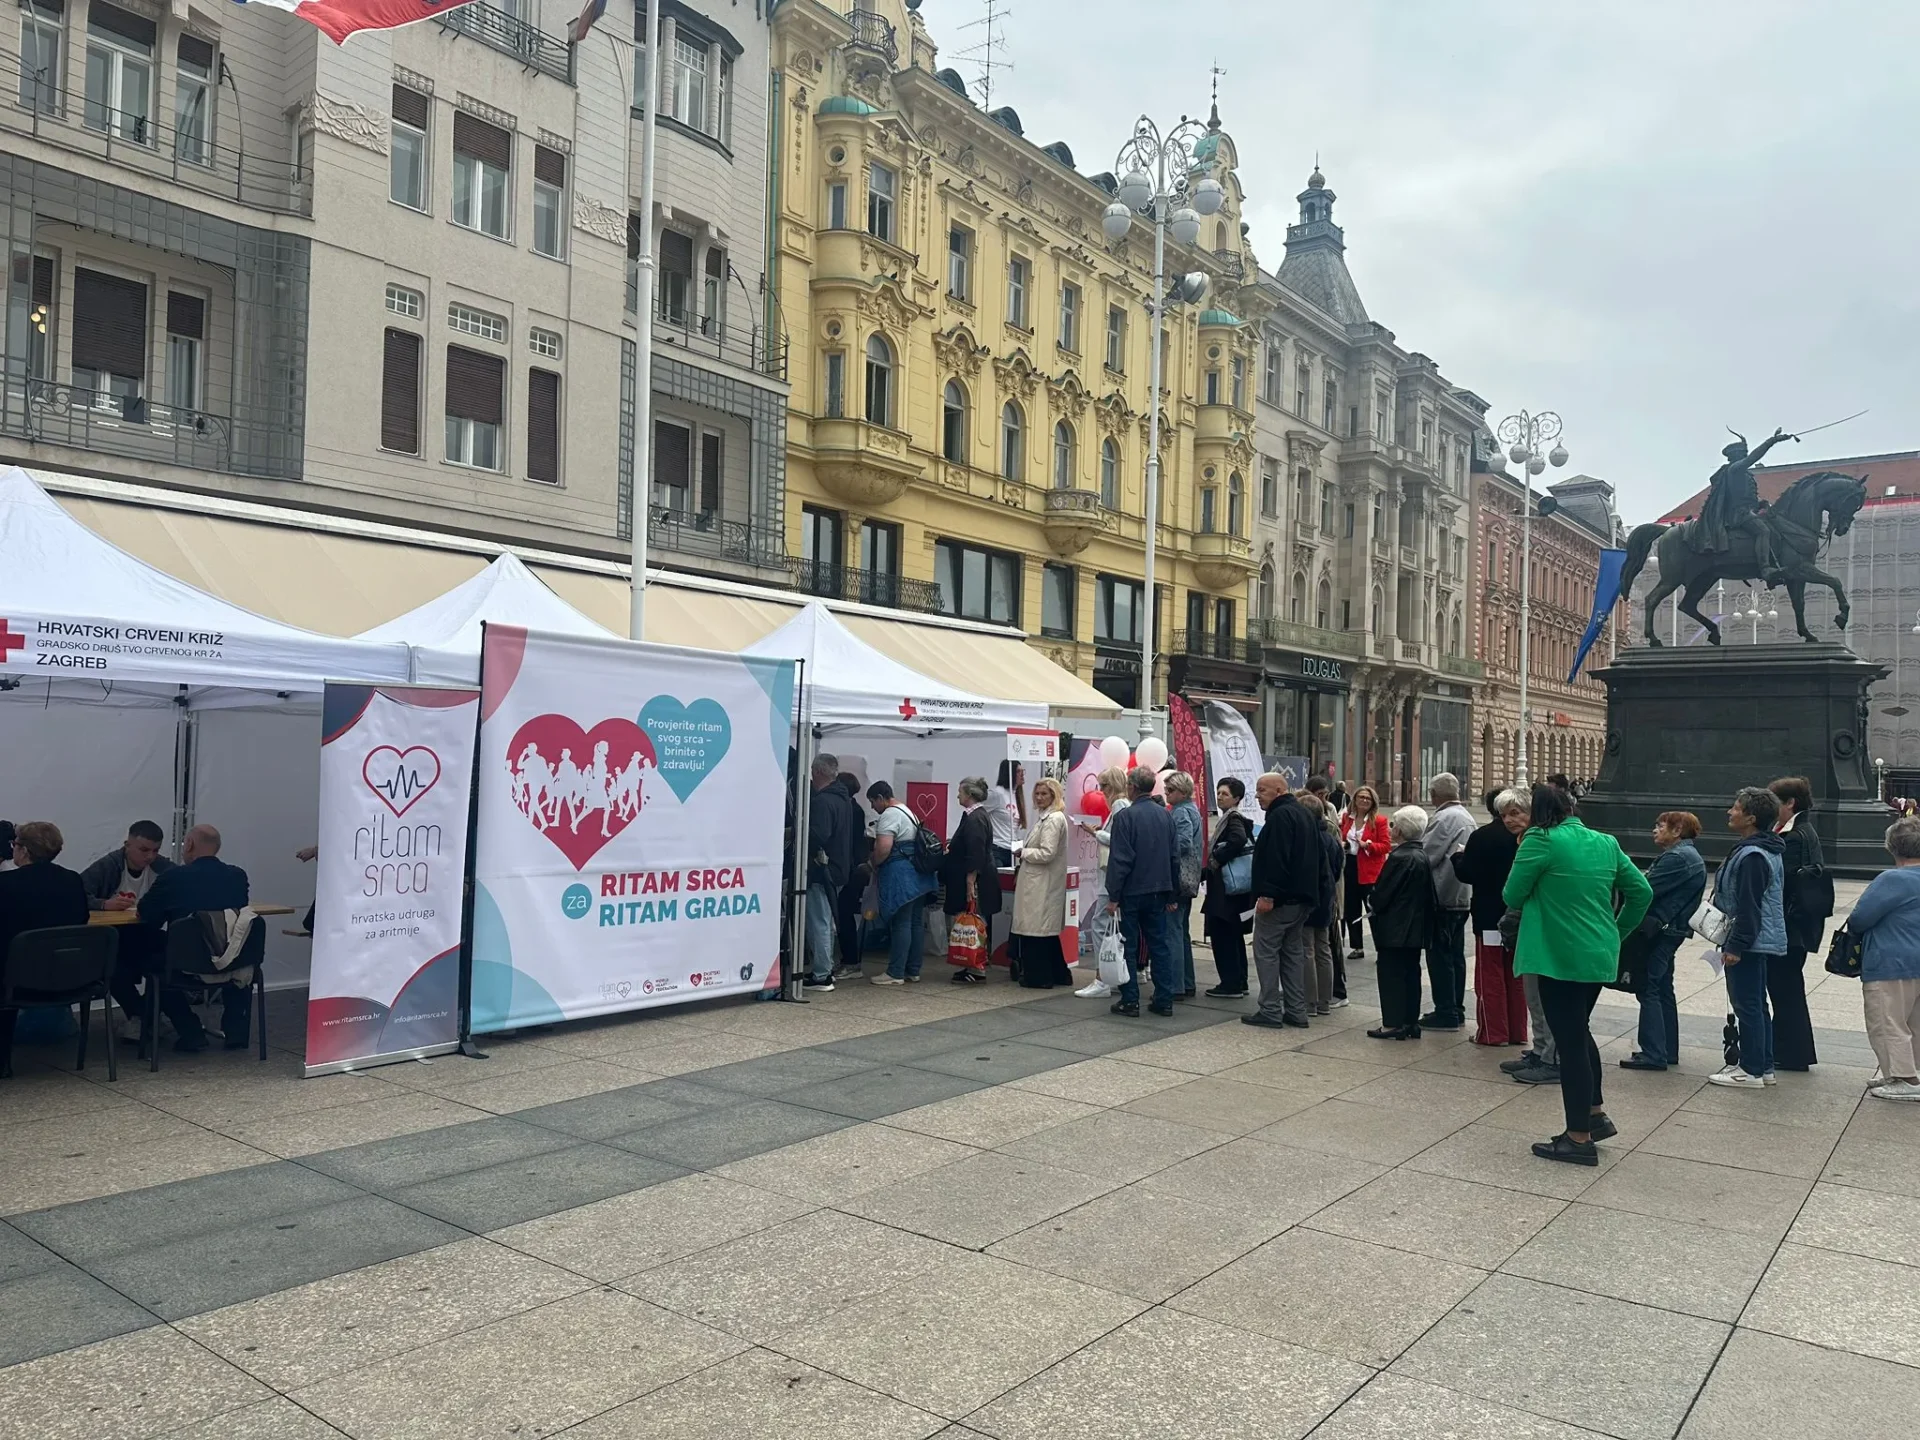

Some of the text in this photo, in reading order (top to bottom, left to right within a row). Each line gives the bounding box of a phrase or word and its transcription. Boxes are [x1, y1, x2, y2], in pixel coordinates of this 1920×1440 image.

[37, 621, 224, 646] HRVATSKI CRVENI KRIŽ
[36, 639, 90, 651] GRADSKO
[144, 647, 192, 657] CRVENOG
[36, 653, 107, 670] ZAGREB
[1303, 657, 1341, 679] DOUGLAS
[647, 718, 723, 732] Provjerite ritam
[657, 734, 681, 745] svog
[683, 736, 704, 744] srca
[664, 746, 705, 757] brinite o
[663, 760, 705, 772] zdravlju!
[354, 813, 442, 860] ritam
[363, 861, 429, 897] srca
[600, 867, 745, 897] RITAM SRCA
[566, 894, 587, 910] za
[599, 893, 761, 927] RITAM GRADA
[351, 908, 435, 925] hrvatska udruga
[365, 925, 420, 940] za aritmije
[321, 1012, 381, 1027] www.ritamsrca.hr
